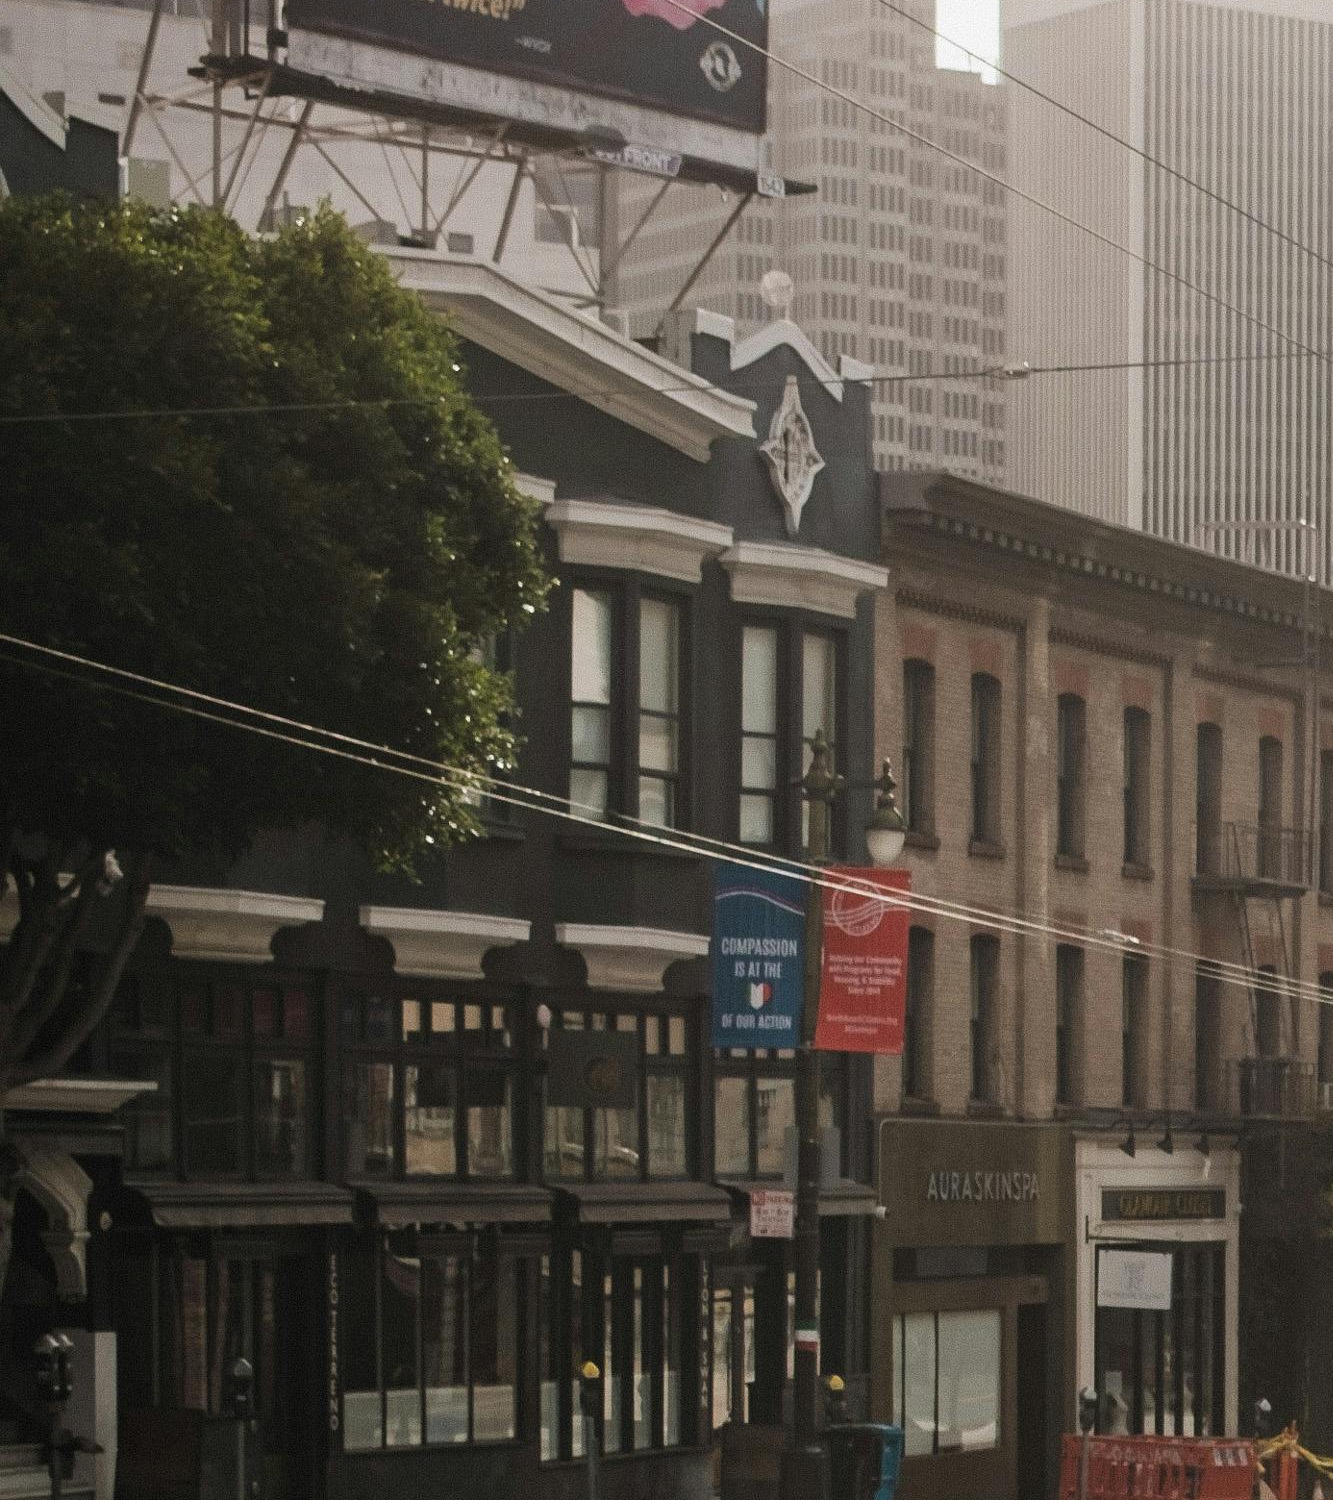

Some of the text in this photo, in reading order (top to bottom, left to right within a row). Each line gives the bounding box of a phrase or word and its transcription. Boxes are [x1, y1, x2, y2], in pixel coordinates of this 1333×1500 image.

[594, 143, 672, 173] FRONT
[721, 937, 798, 957] COMPASSION
[735, 961, 782, 979] IS AT THE
[722, 1013, 792, 1030] OF OUR ACTION
